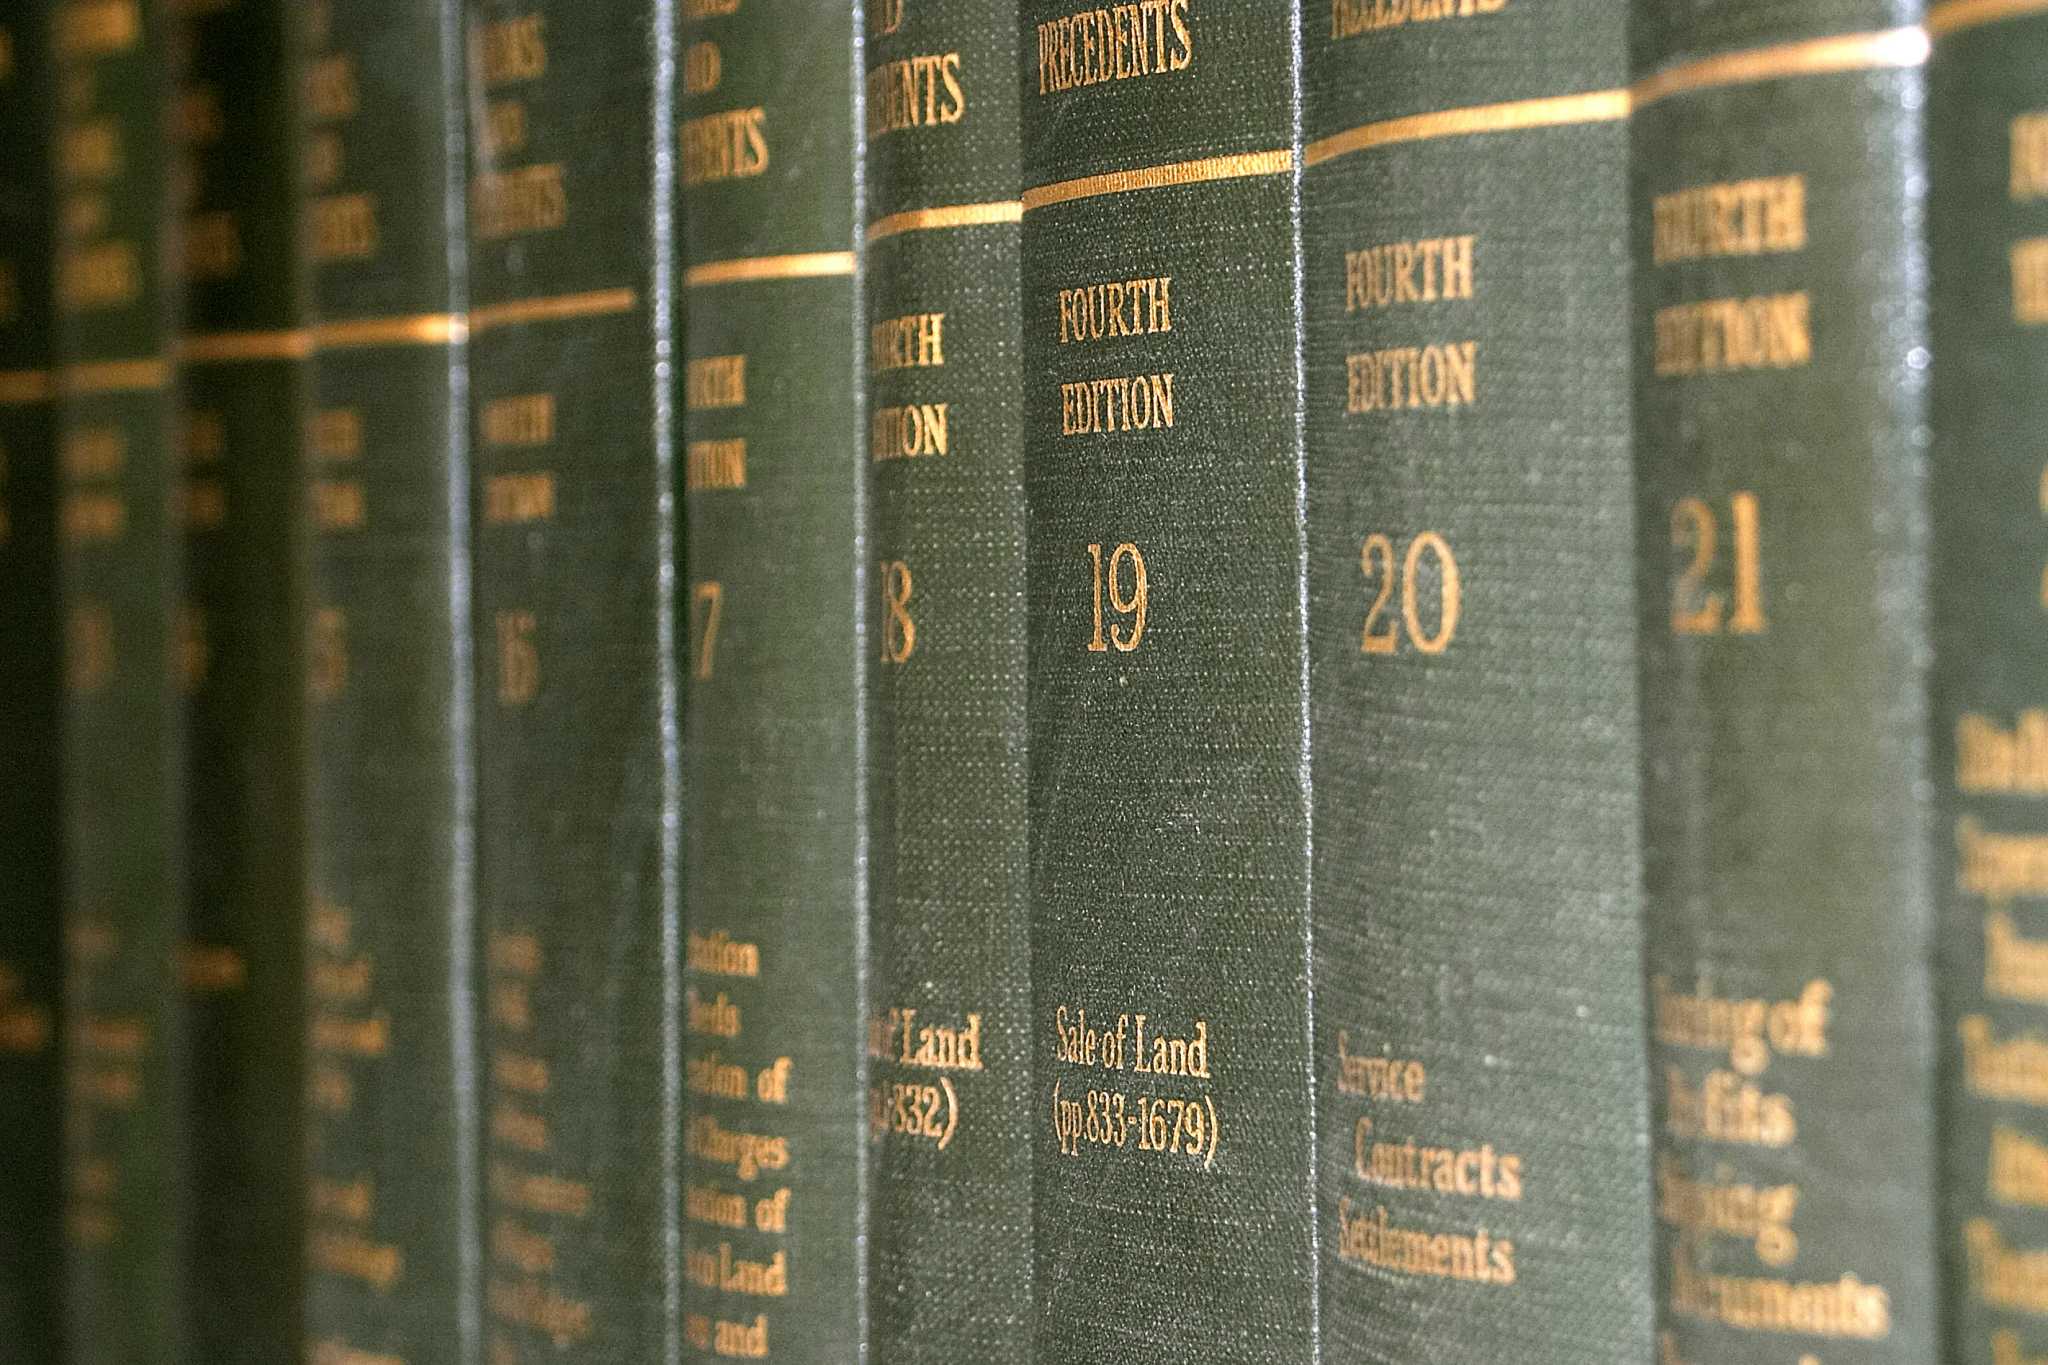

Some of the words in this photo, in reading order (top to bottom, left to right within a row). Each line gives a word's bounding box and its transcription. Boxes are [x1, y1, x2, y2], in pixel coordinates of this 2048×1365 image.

[1038, 0, 1192, 95] PRECEDENTS
[1059, 277, 1172, 343] FOURTH
[1345, 234, 1475, 312] FOURTH
[1061, 373, 1174, 435] EDITION
[1346, 340, 1477, 414] EDITION
[1087, 543, 1147, 651] 19
[1361, 529, 1462, 654] 20
[1670, 490, 1768, 635] 21
[900, 1008, 984, 1071] Land
[1057, 1005, 1096, 1066] Sale
[1102, 1014, 1128, 1069] of
[1134, 1014, 1210, 1078] Land
[1769, 977, 1833, 1057] of
